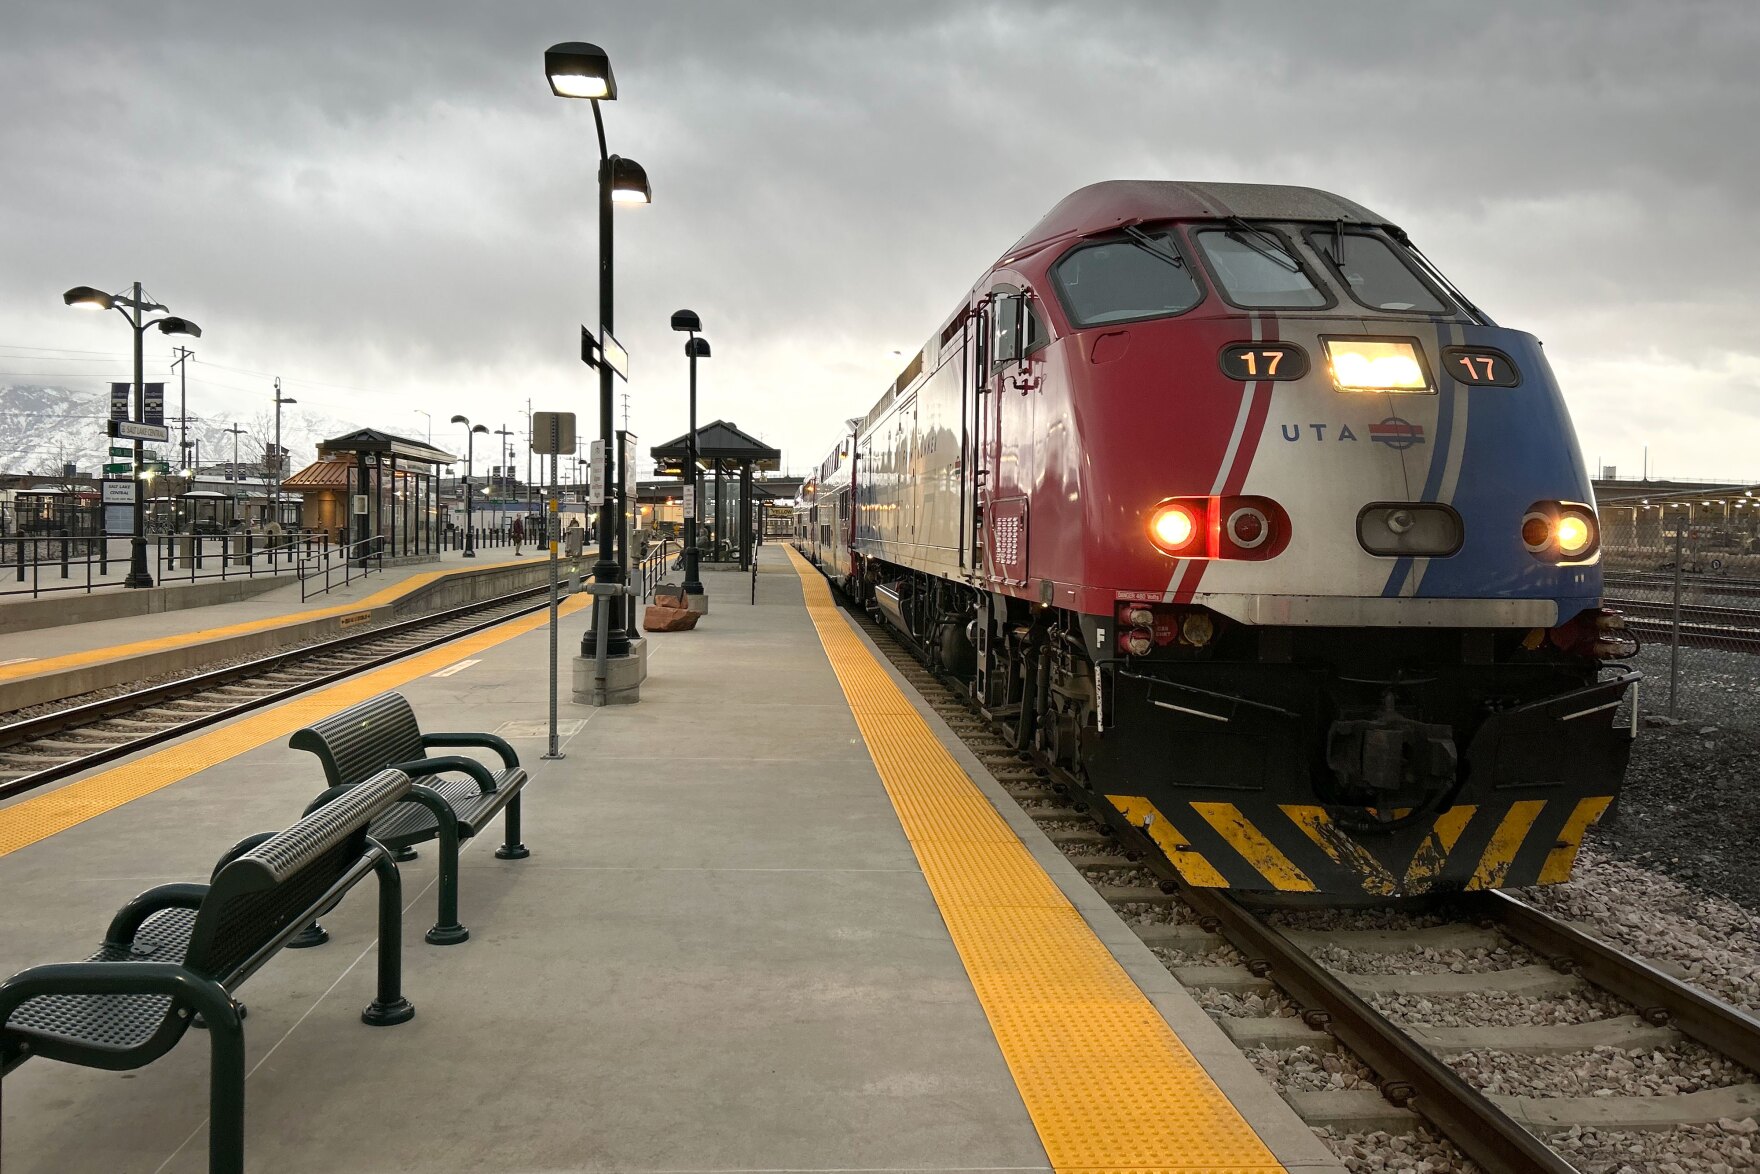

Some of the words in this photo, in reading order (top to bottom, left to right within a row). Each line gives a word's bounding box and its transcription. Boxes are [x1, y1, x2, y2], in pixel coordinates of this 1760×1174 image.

[1240, 351, 1284, 375] 17
[1459, 356, 1494, 381] 17
[1281, 423, 1358, 442] UTA
[1096, 628, 1106, 649] F
